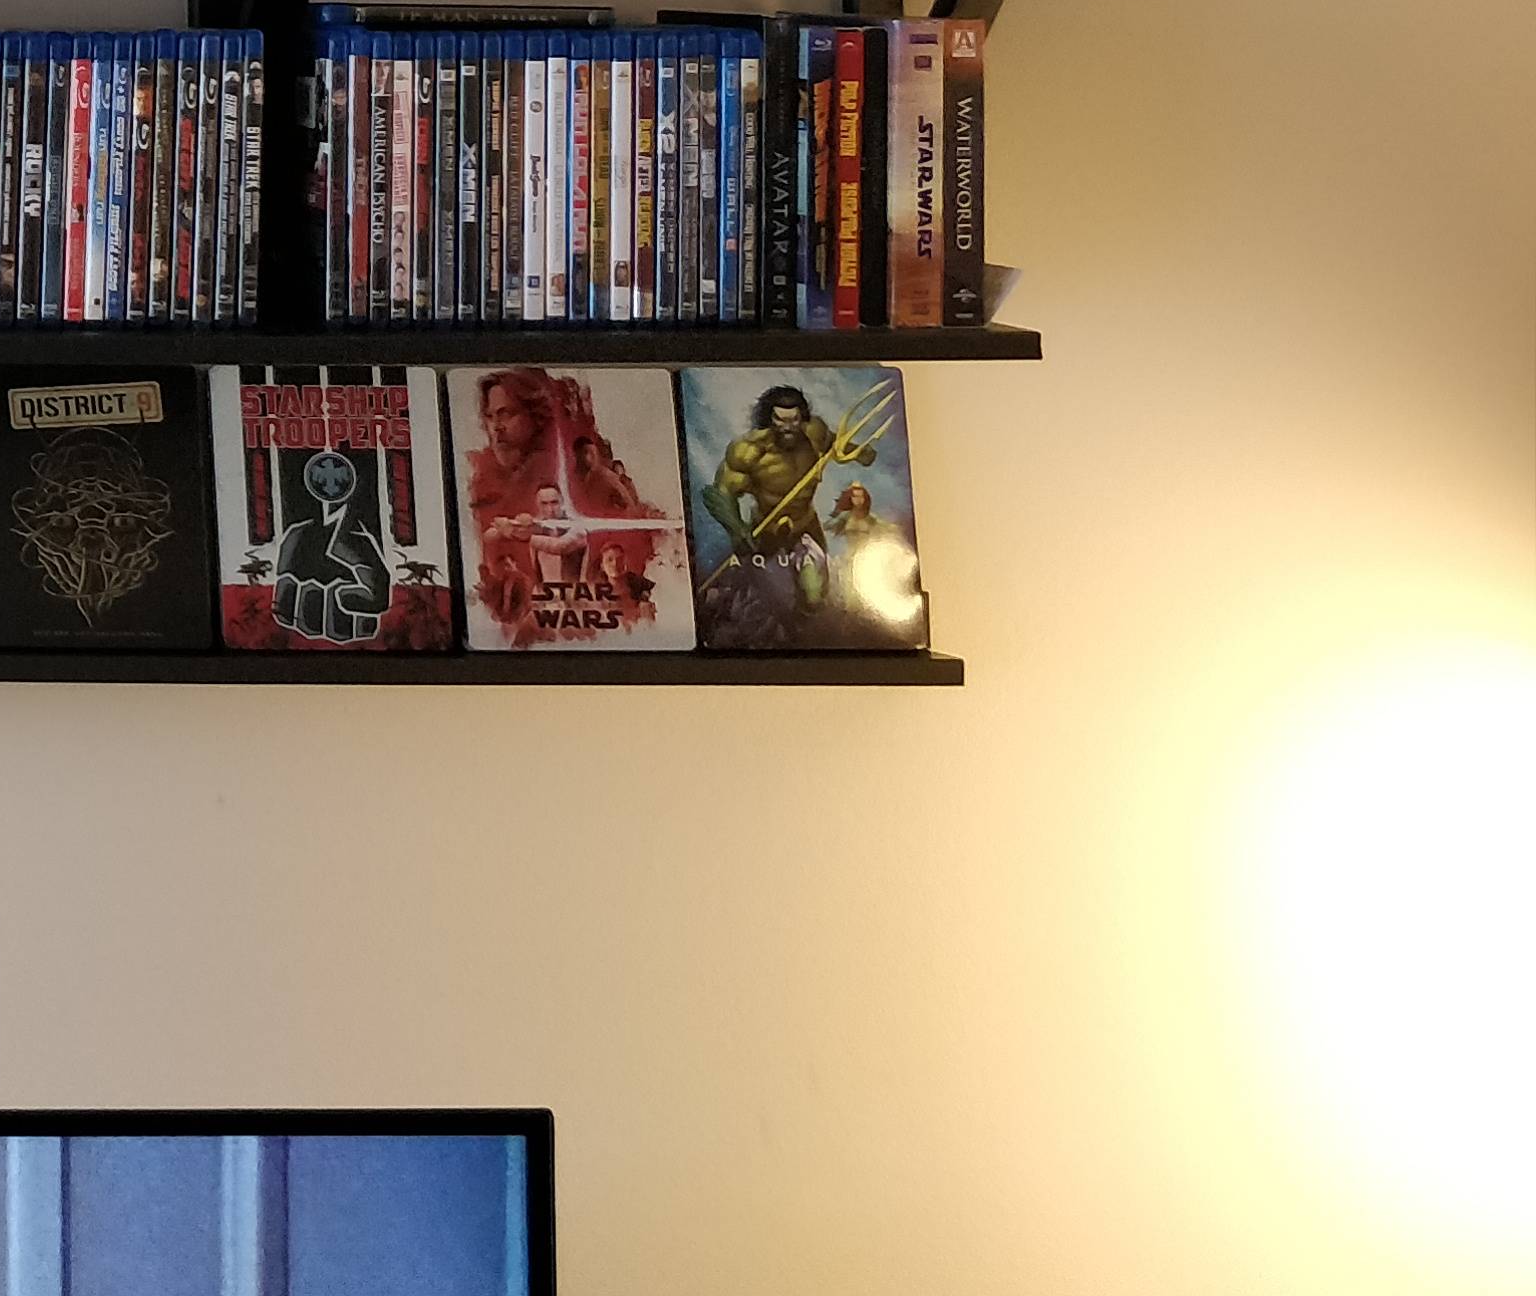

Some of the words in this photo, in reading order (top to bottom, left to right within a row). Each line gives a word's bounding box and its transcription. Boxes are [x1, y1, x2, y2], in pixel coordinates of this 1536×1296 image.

[838, 80, 859, 111] PULP
[246, 126, 261, 157] STAR
[373, 106, 387, 184] AMERICAN
[839, 112, 860, 157] FICTION
[917, 115, 934, 187] STAR
[24, 143, 43, 218] ROCKY
[245, 159, 261, 190] TREK
[955, 96, 974, 251] WATERWORLD
[372, 191, 386, 244] PSYCHO
[771, 151, 790, 255] AVATAR
[917, 187, 934, 260] WARS
[837, 242, 859, 288] FICTION
[20, 393, 127, 419] DISTRICT
[135, 391, 152, 411] 9
[240, 385, 410, 418] STARSHIP
[243, 417, 411, 449] TROOPERS
[532, 582, 618, 601] STAR
[533, 610, 624, 629] WARS
